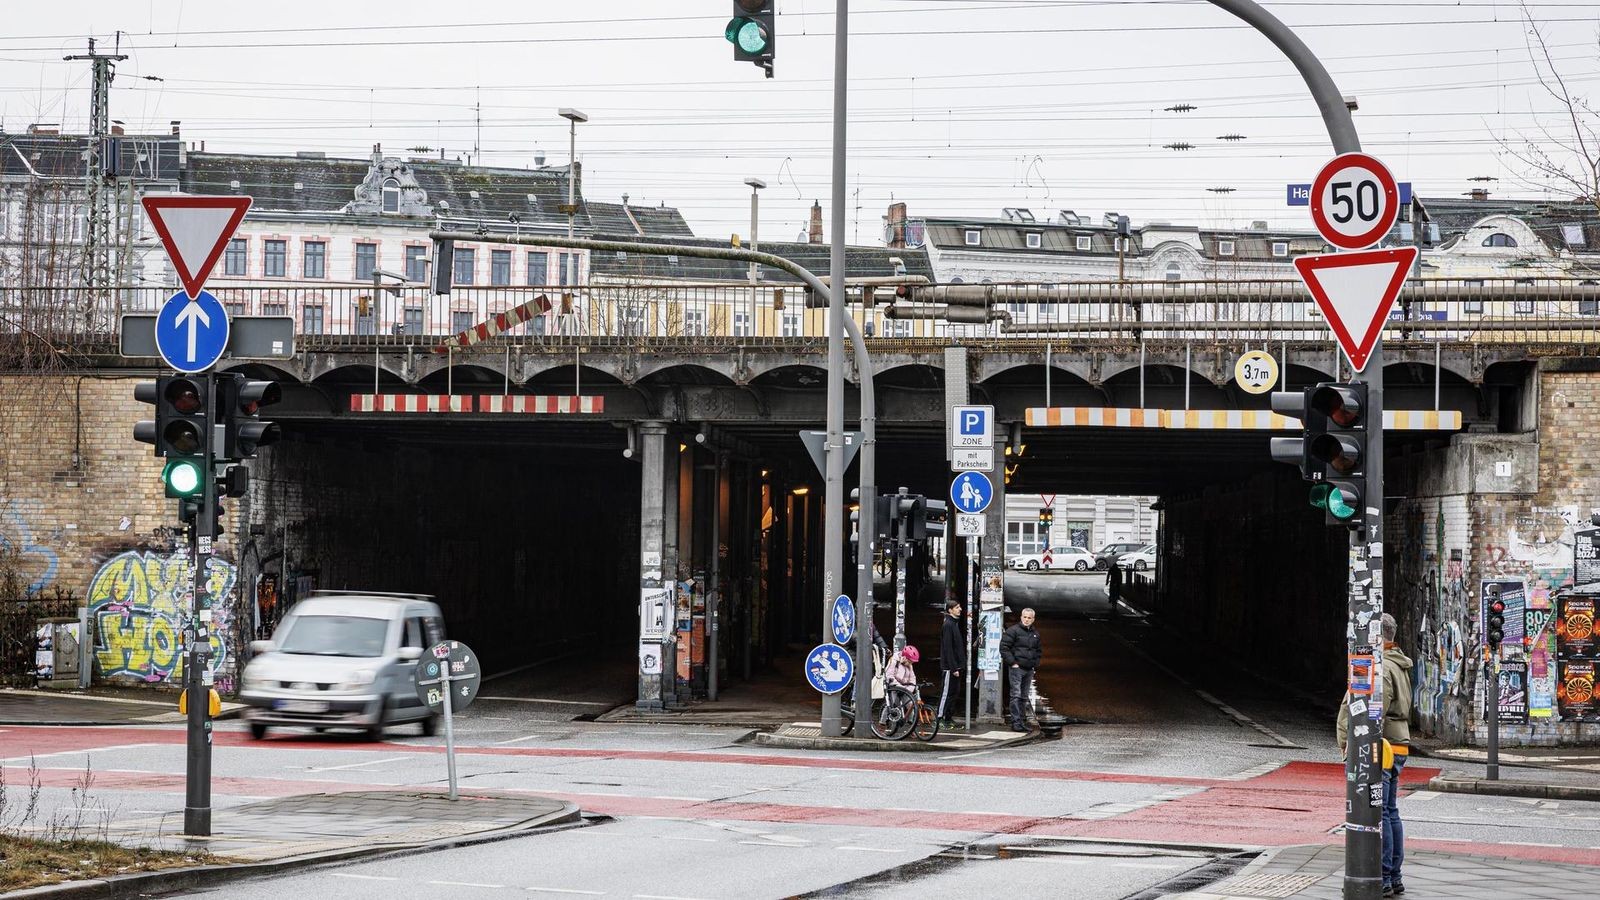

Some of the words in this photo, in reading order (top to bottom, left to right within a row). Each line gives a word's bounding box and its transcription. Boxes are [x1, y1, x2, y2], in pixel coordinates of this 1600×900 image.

[1292, 187, 1310, 199] Ha
[1331, 180, 1379, 224] 50
[966, 413, 979, 431] P
[957, 459, 988, 468] Parkschein
